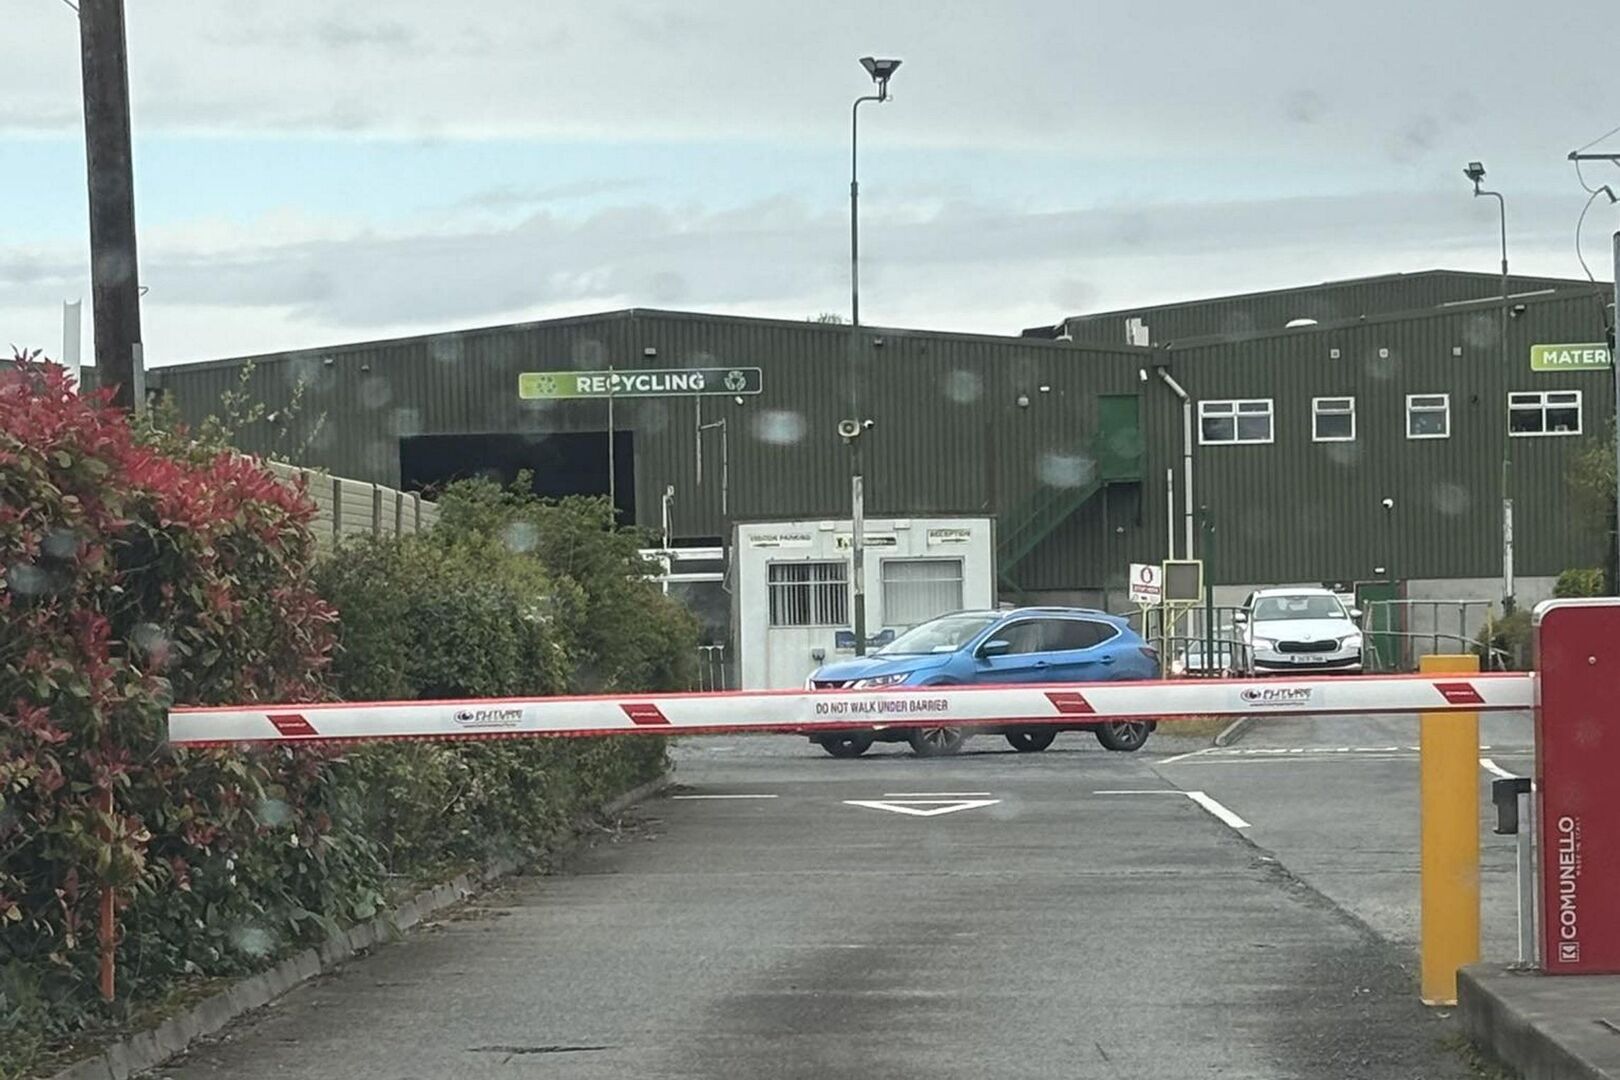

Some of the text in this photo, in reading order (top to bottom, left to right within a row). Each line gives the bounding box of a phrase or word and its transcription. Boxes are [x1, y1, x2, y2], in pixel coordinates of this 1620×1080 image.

[576, 373, 705, 392] RECYCLING
[816, 699, 948, 714] DO NOT WALK UNDER BARRIER
[1558, 816, 1576, 939] COMUNELLO
